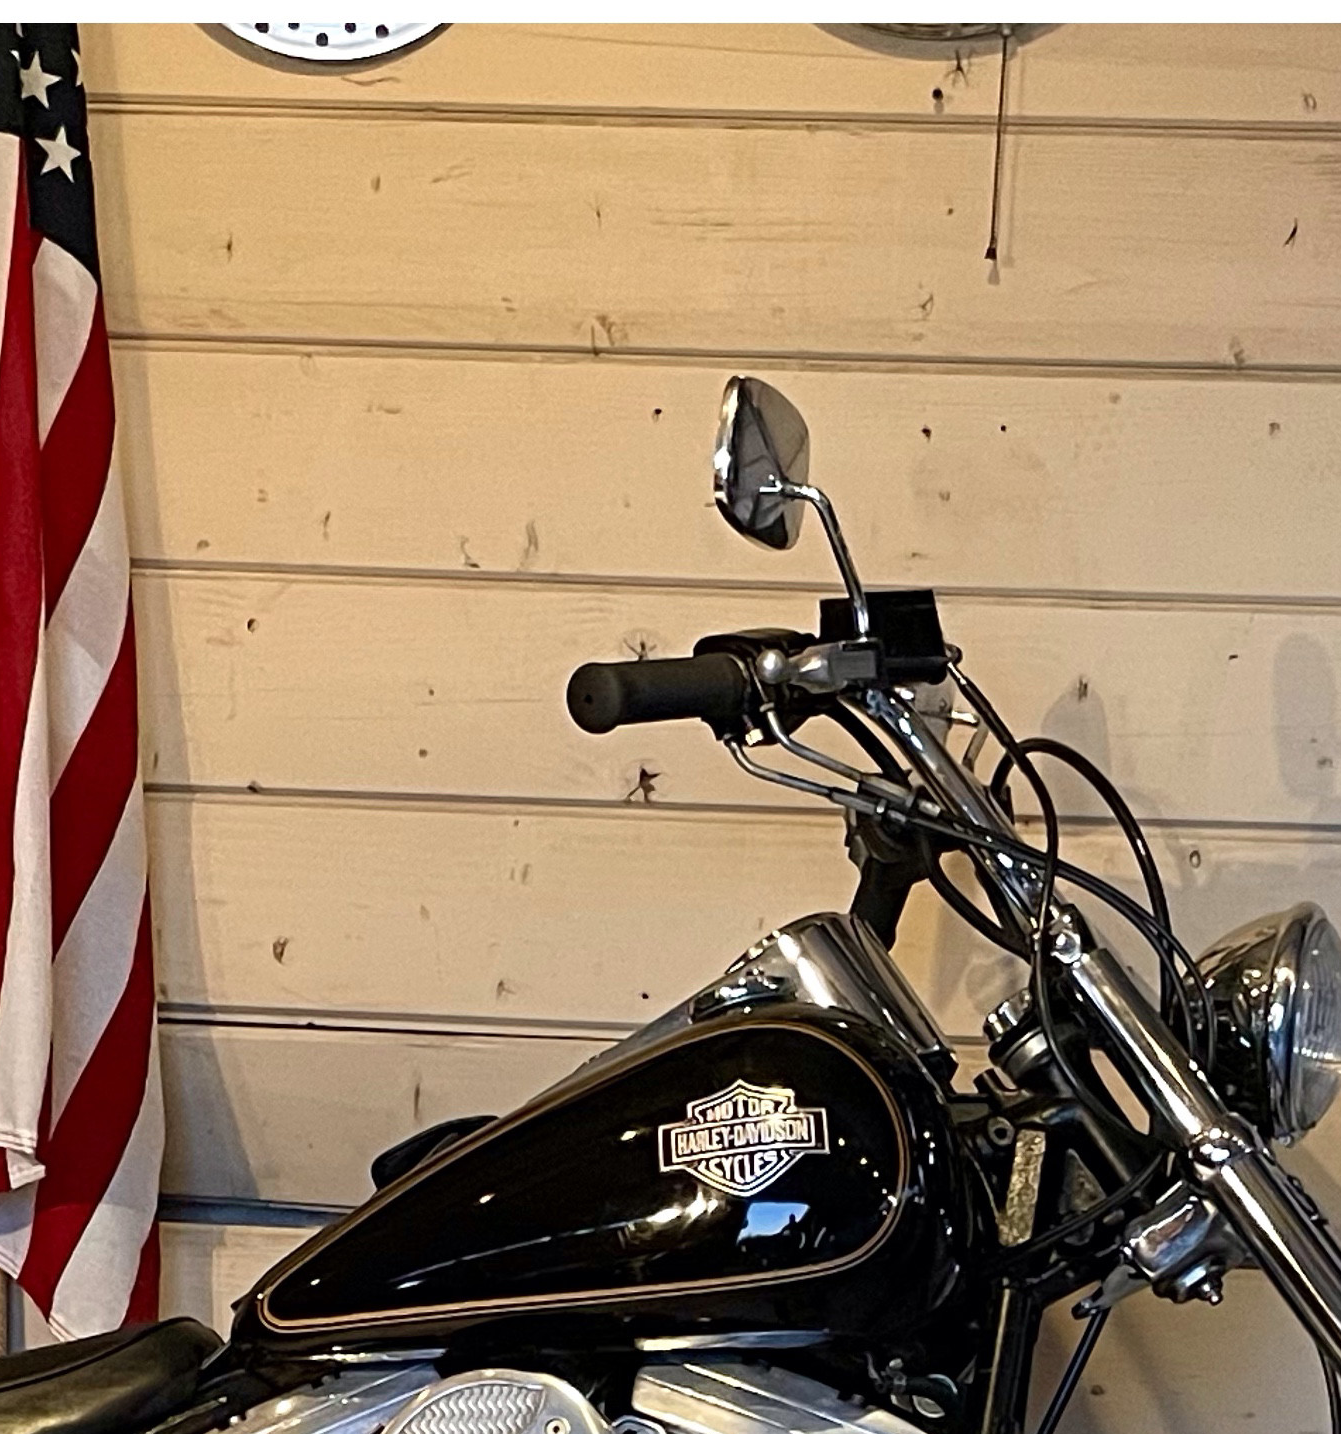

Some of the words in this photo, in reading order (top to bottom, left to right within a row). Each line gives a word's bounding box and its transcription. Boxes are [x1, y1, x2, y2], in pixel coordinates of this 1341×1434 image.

[705, 1095, 776, 1121] MOTOR
[677, 1119, 810, 1156] HARLEY-DAVIDSON
[709, 1150, 778, 1184] CYCLES
